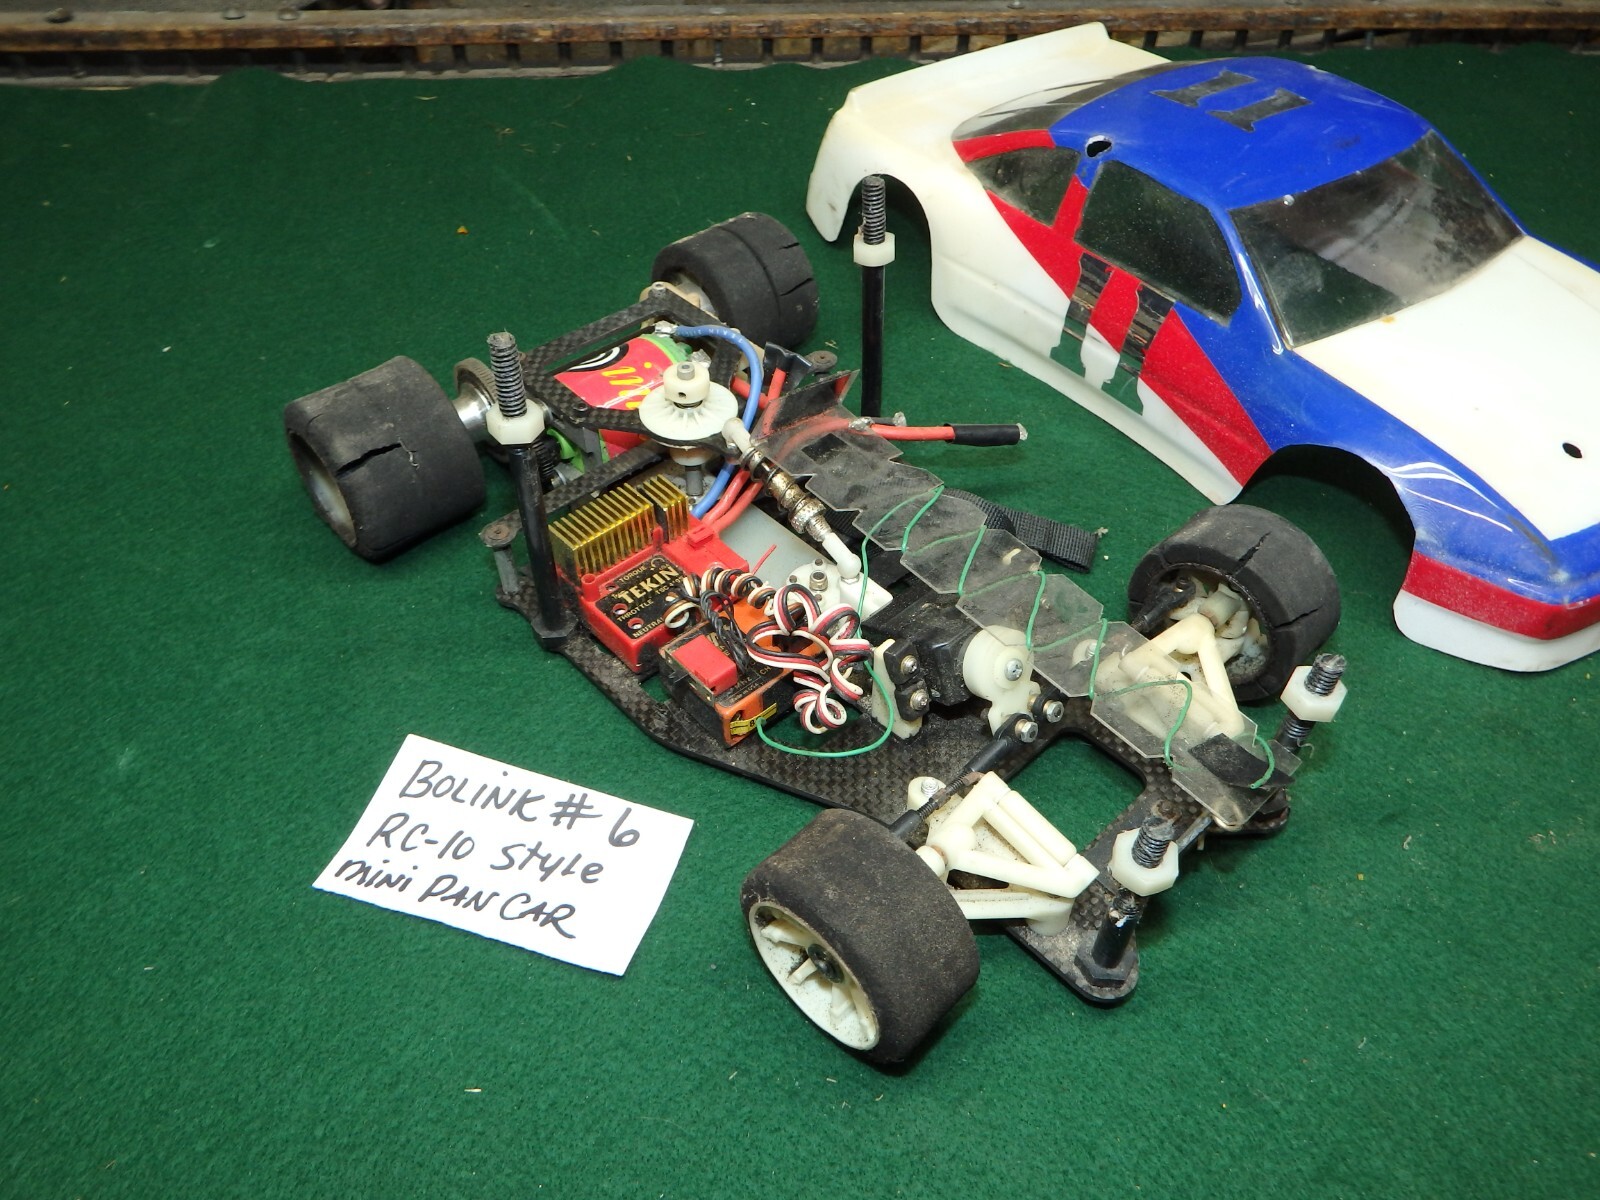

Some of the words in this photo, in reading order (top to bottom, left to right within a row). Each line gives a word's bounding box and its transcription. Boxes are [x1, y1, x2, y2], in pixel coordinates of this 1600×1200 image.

[617, 565, 680, 604] TEKIN
[619, 565, 647, 583] TORQUE
[616, 599, 654, 622] THROTTLE
[366, 812, 475, 860] RC-10
[418, 875, 500, 912] PAN
[499, 893, 576, 939] CAR
